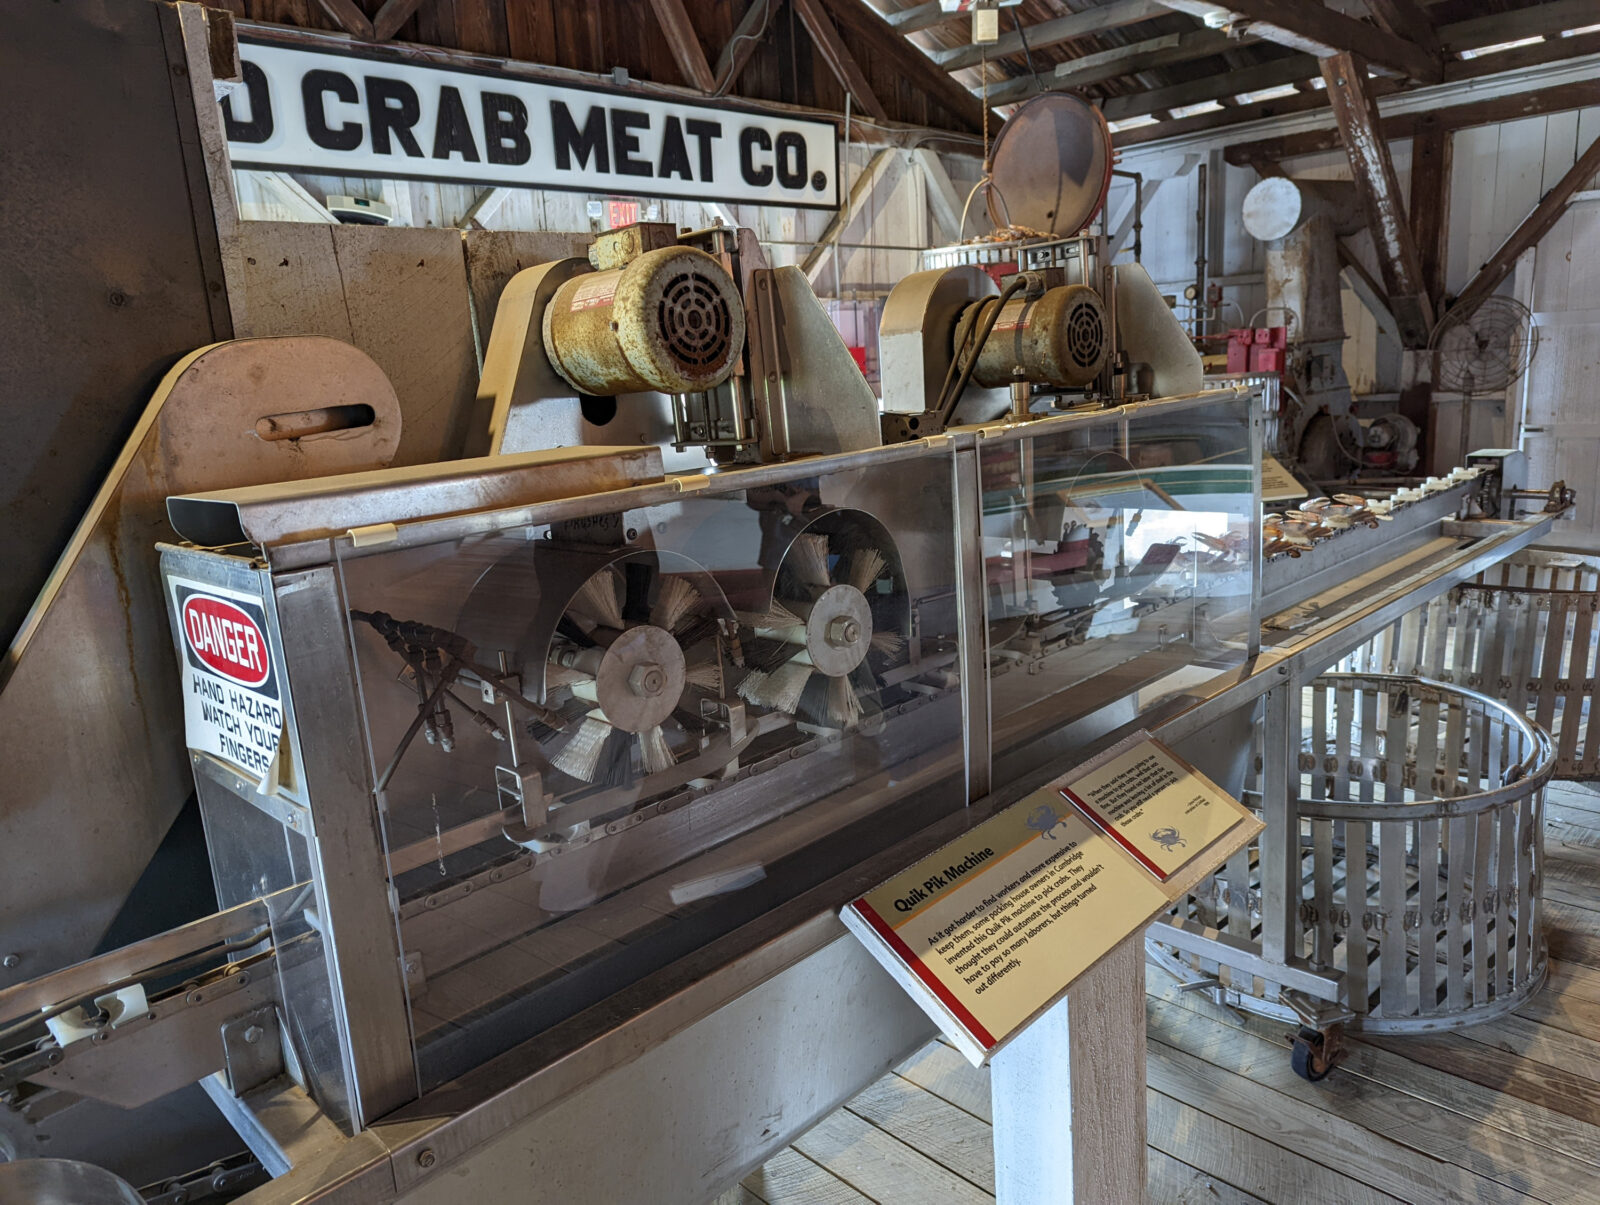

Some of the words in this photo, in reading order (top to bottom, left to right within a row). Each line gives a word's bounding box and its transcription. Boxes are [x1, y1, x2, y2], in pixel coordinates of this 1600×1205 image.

[301, 69, 532, 166] CRAB
[550, 100, 722, 183] MEAT
[740, 127, 828, 192] CO.
[610, 201, 637, 227] EXIT
[188, 608, 262, 673] DANGER
[193, 673, 224, 705] HAND
[229, 689, 282, 729] HAZARD
[201, 700, 242, 737] WATCH
[219, 733, 270, 774] FINGERS
[894, 888, 928, 912] Quik
[923, 876, 948, 893] Pik
[943, 848, 994, 881] Machine
[928, 936, 939, 946] As
[944, 924, 957, 936] got
[954, 910, 977, 926] harder
[982, 895, 997, 907] find
[996, 881, 1020, 898] workers
[1020, 871, 1031, 882] and
[1030, 863, 1046, 875] more
[1045, 846, 1071, 865] expensive
[936, 942, 954, 955] keep
[953, 930, 974, 943] them,
[972, 917, 990, 930] some
[989, 900, 1014, 920] packing
[1010, 889, 1030, 903] house
[1029, 874, 1050, 890] owners
[1054, 851, 1084, 872] Cambridge
[945, 941, 975, 964] invented
[973, 934, 987, 944] this
[986, 923, 1003, 935] Quik
[1000, 916, 1012, 925] Pik
[1011, 899, 1036, 918] machine
[1042, 885, 1055, 897] pick
[1054, 875, 1071, 887] crabs.
[1068, 865, 1084, 876] They
[955, 953, 983, 974] thought
[981, 943, 997, 955] they
[996, 929, 1014, 944] could
[1013, 911, 1042, 933] automate
[1040, 903, 1052, 912] the
[1050, 888, 1072, 906] process
[1071, 879, 1082, 890] and
[963, 970, 983, 984] have
[981, 964, 990, 972] to
[990, 955, 1003, 968] pay
[1002, 949, 1011, 957] so
[1010, 936, 1028, 951] many
[1025, 919, 1054, 938] laborers,
[1049, 910, 1063, 920] but
[1060, 898, 1079, 912] things
[1077, 883, 1097, 900] turned
[975, 982, 988, 994] out
[987, 959, 1021, 985] differently.
